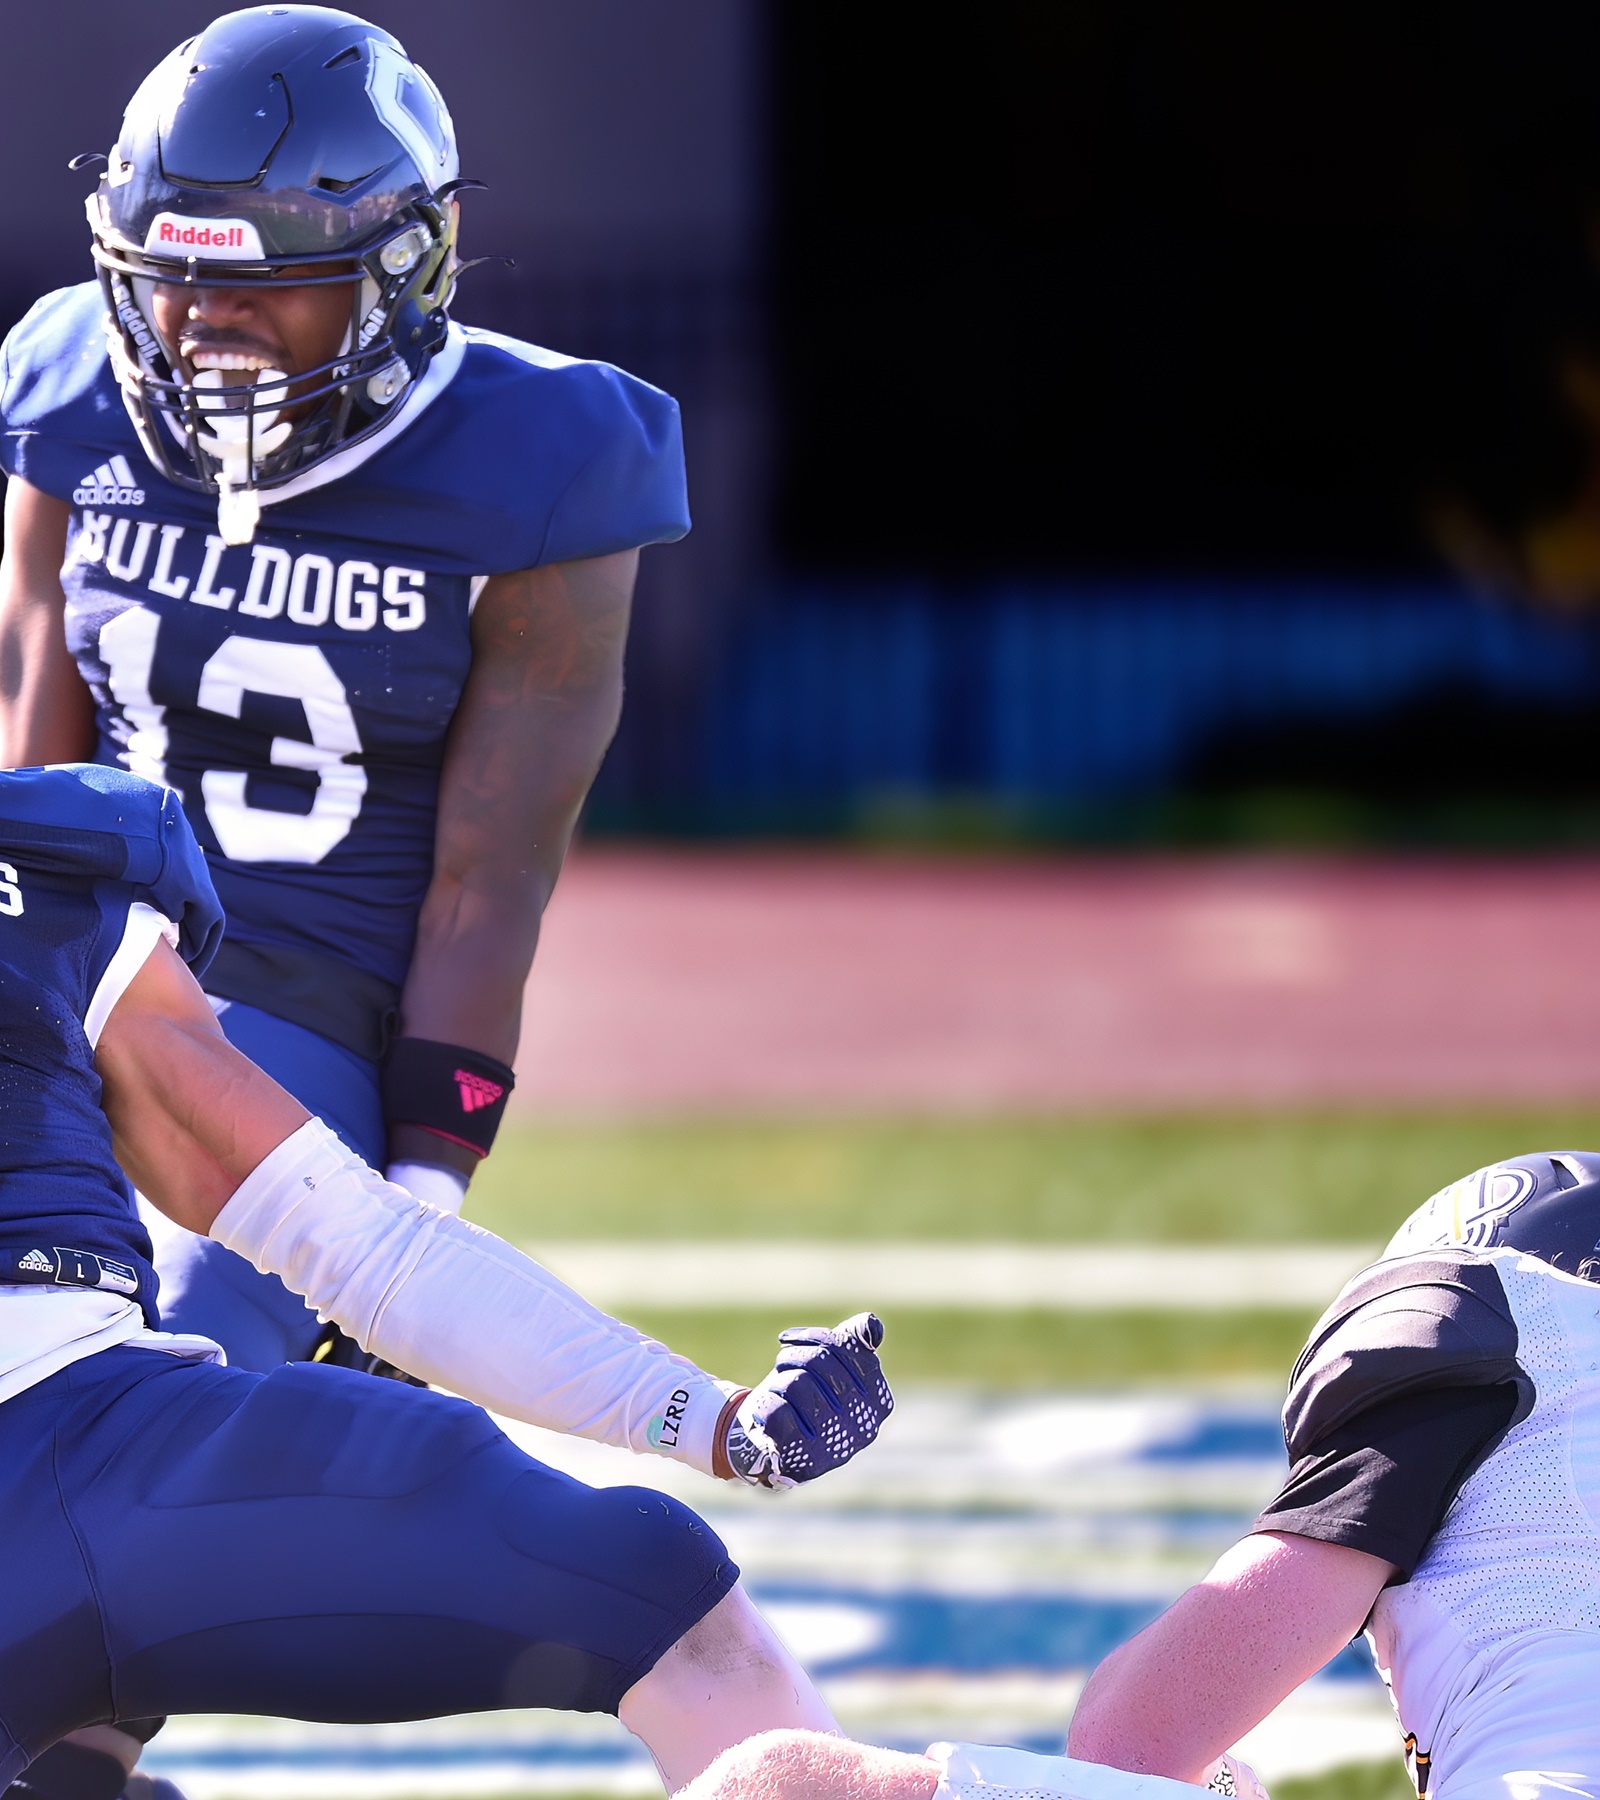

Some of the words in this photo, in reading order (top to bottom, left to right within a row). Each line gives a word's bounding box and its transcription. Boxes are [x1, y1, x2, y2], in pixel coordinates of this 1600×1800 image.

[160, 222, 244, 247] Riddell
[73, 484, 146, 506] adidas
[98, 605, 368, 865] 13
[18, 1259, 54, 1274] adidas
[659, 1389, 690, 1447] LZRD
